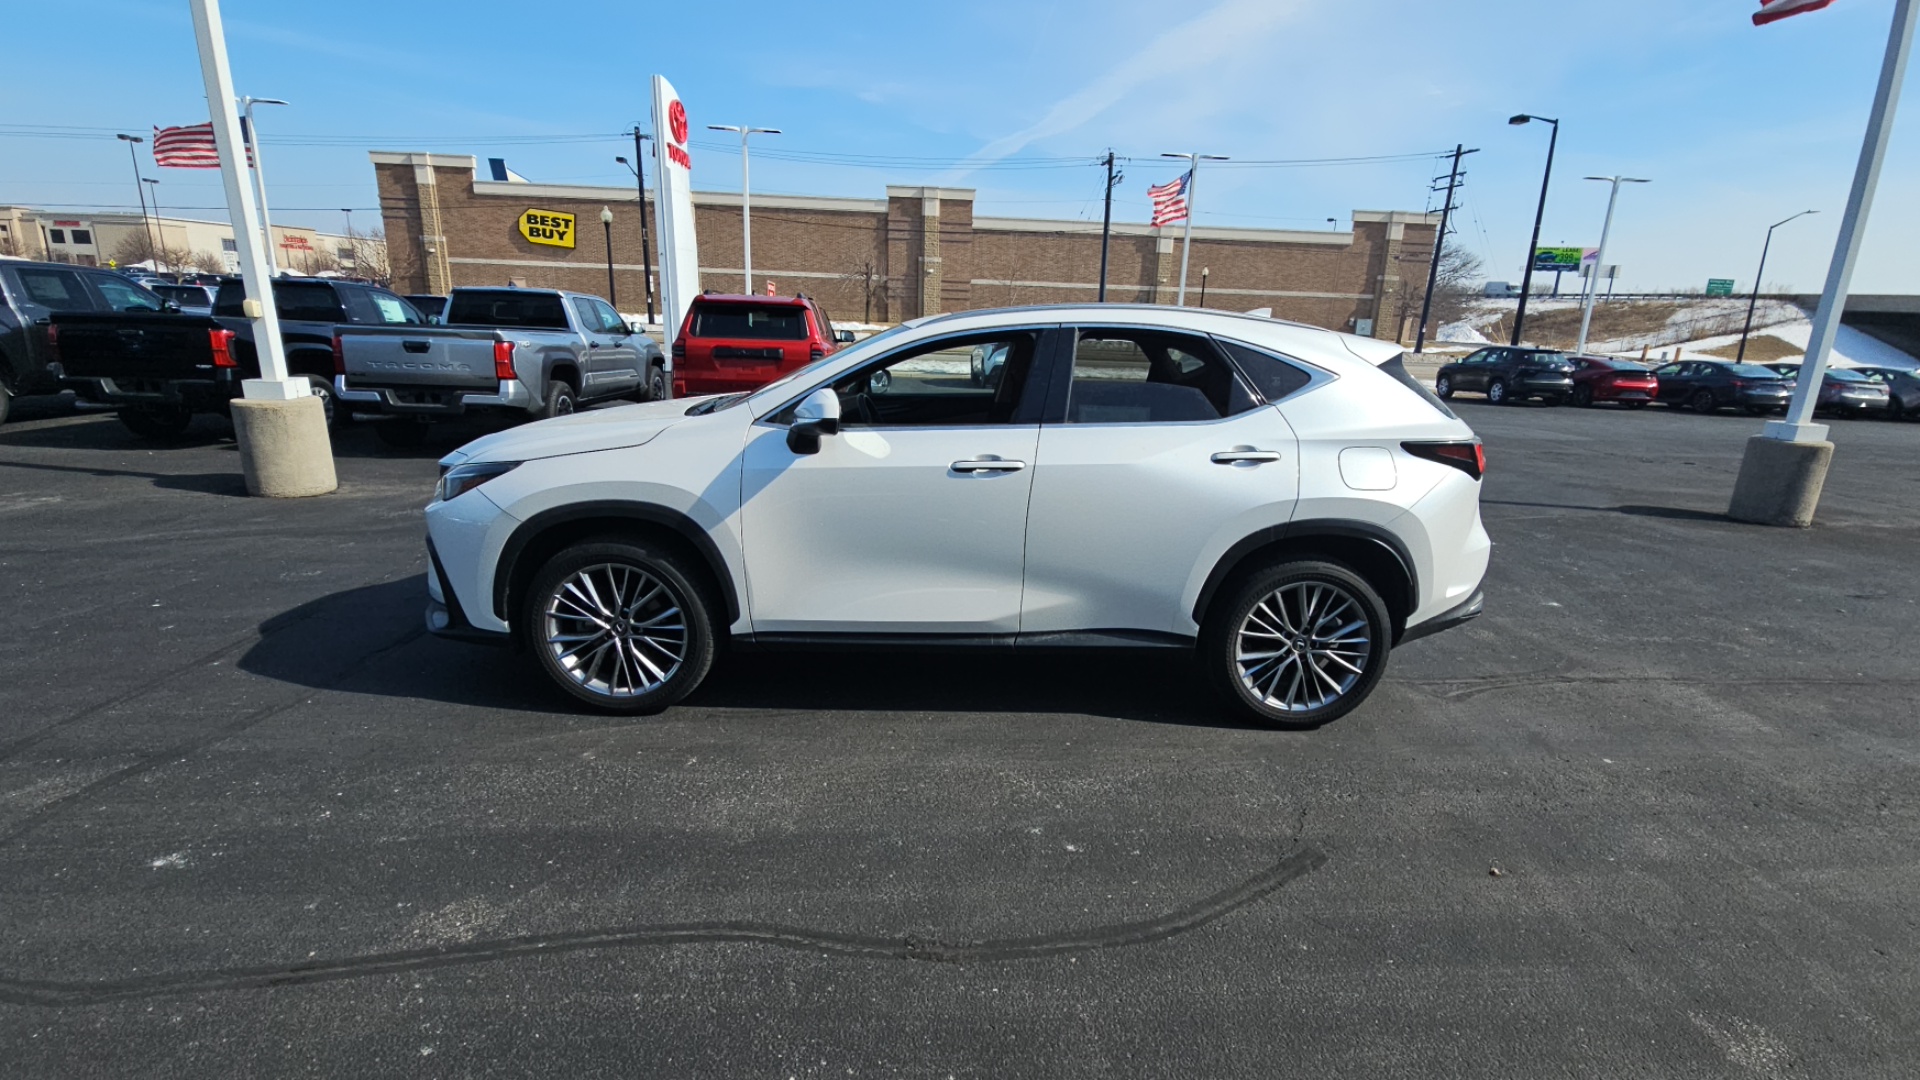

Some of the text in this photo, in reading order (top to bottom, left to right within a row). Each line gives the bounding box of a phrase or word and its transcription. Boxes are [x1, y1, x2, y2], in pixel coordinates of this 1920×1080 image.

[526, 213, 572, 229] BEST
[528, 226, 568, 241] BUY
[366, 361, 472, 372] TACOMA
